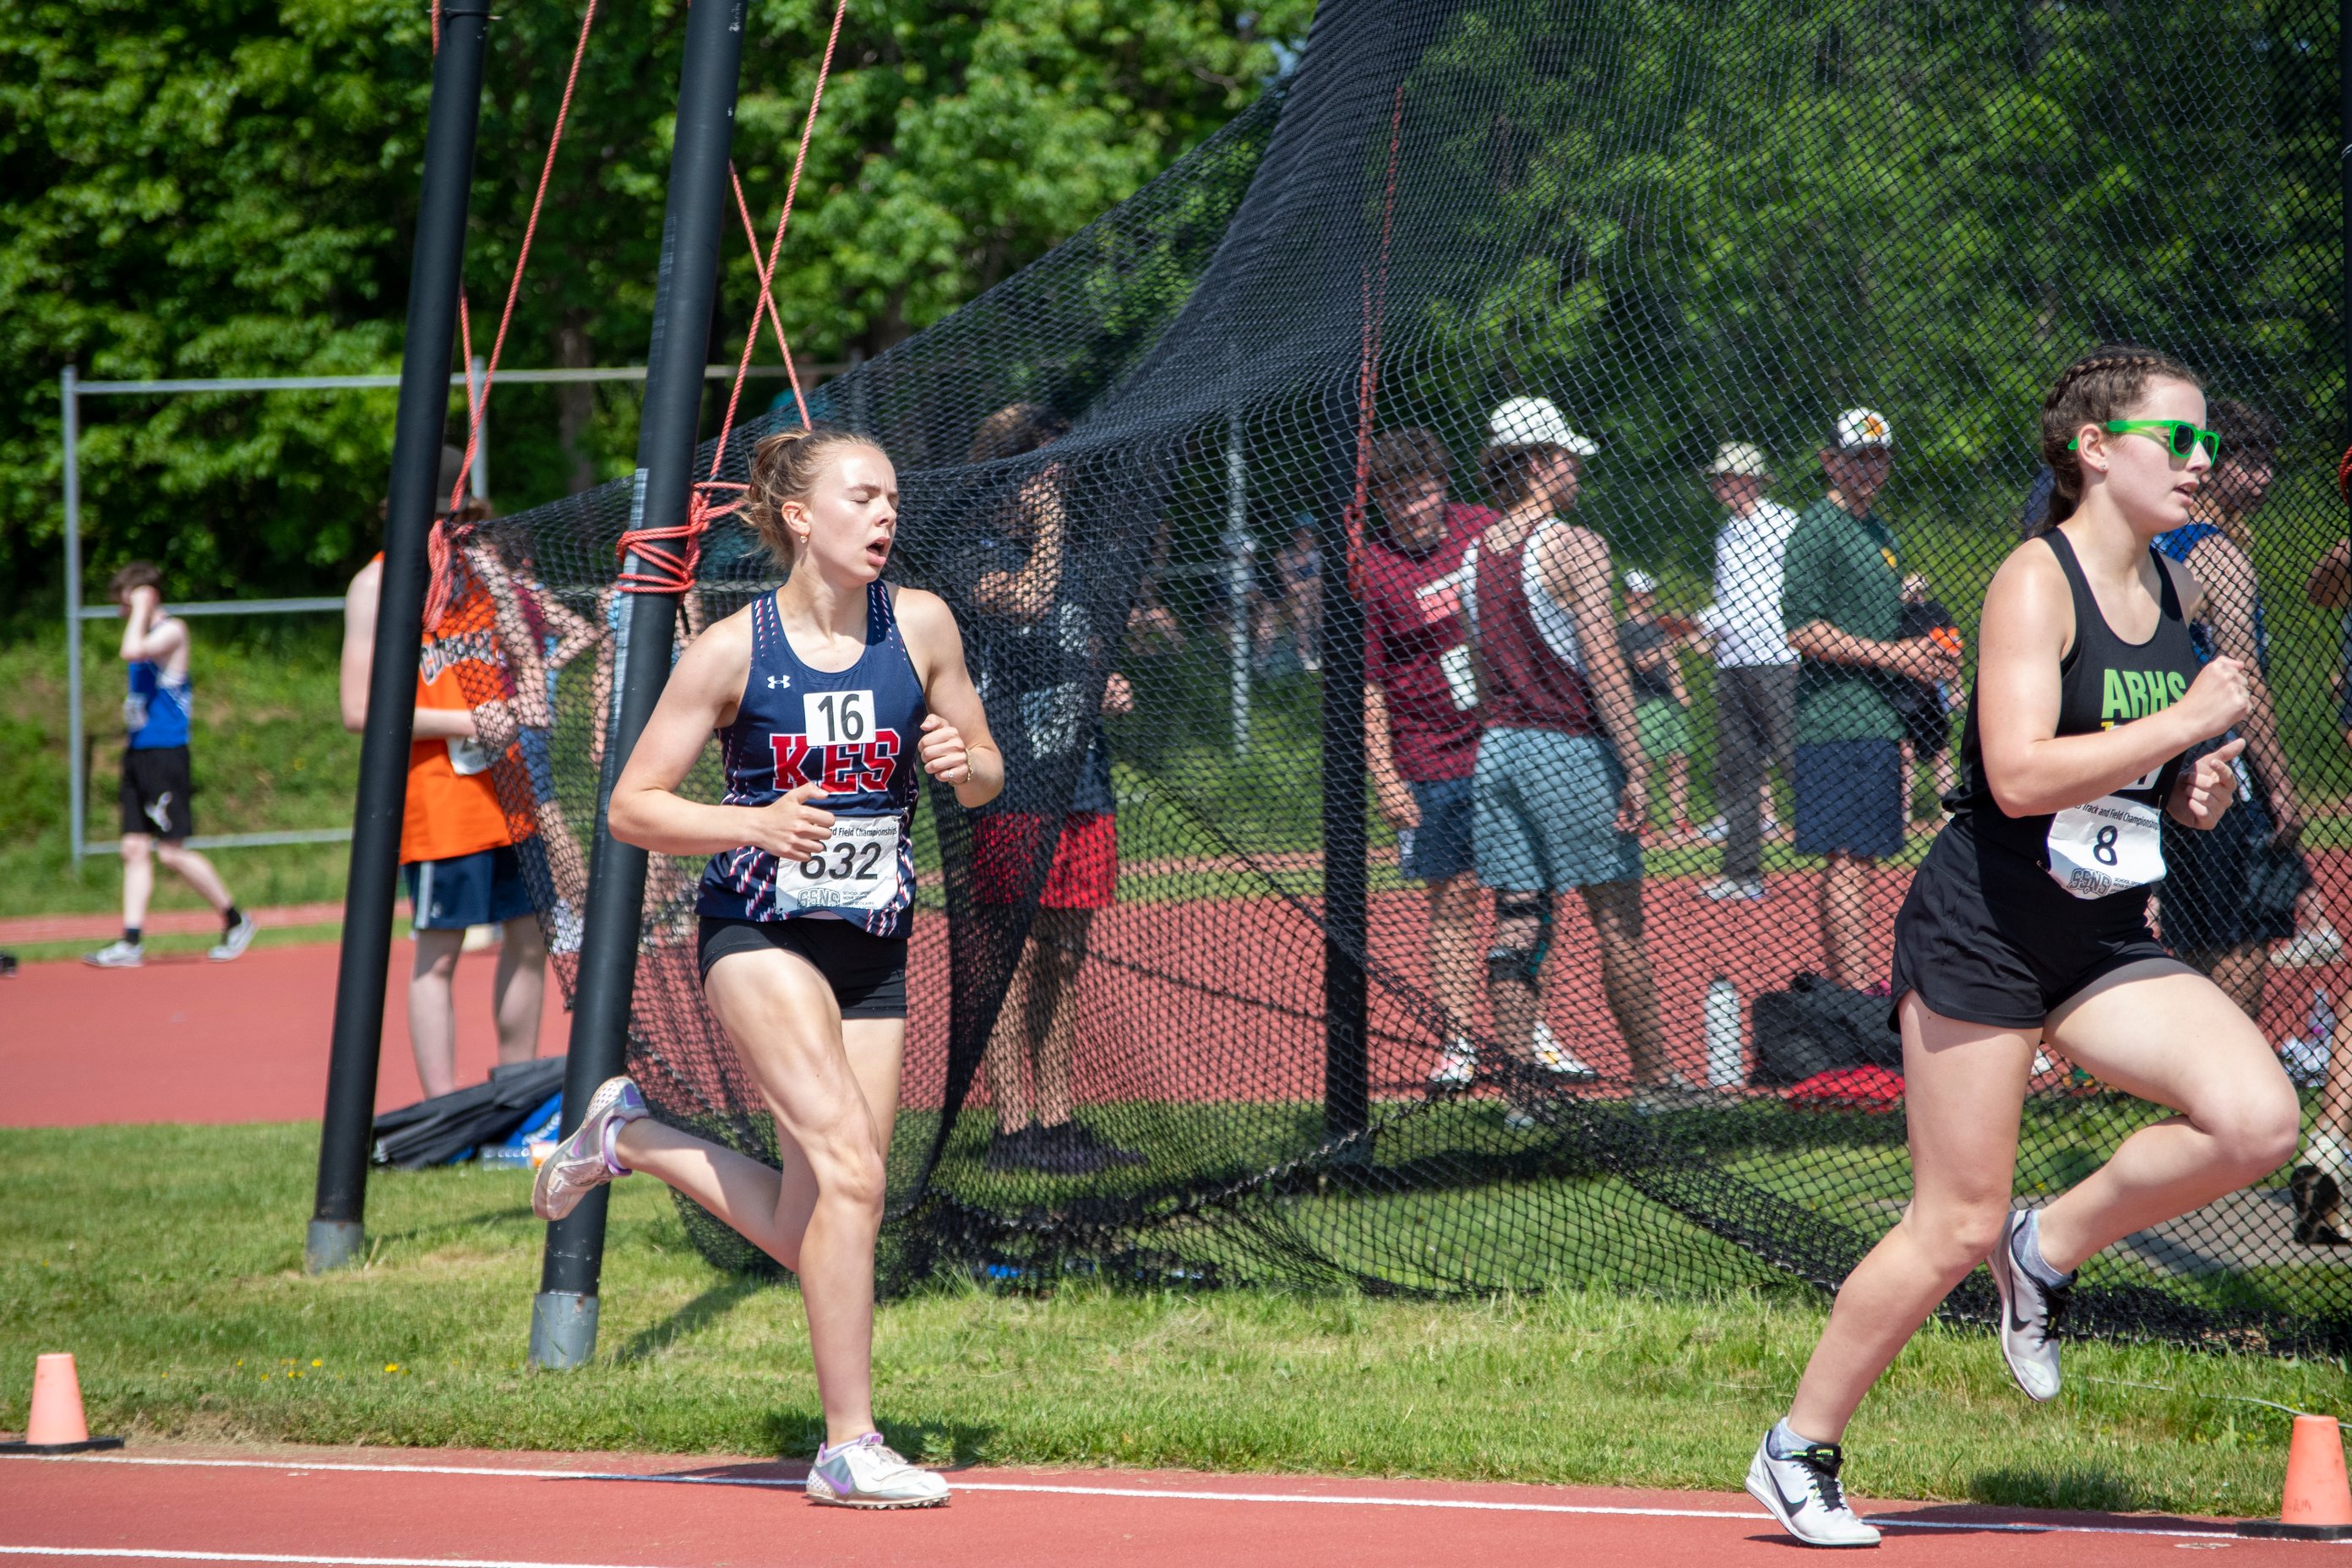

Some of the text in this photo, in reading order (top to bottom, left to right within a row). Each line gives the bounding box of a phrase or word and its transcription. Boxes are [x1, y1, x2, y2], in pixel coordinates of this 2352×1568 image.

[2101, 668, 2186, 719] ARHS
[817, 694, 863, 742] 16
[770, 728, 901, 795] KES
[838, 827, 854, 836] Field
[855, 826, 897, 838] Championships
[2110, 808, 2123, 820] Field
[799, 840, 882, 880] 632
[2093, 825, 2118, 866] 8
[2066, 868, 2112, 897] SSNS
